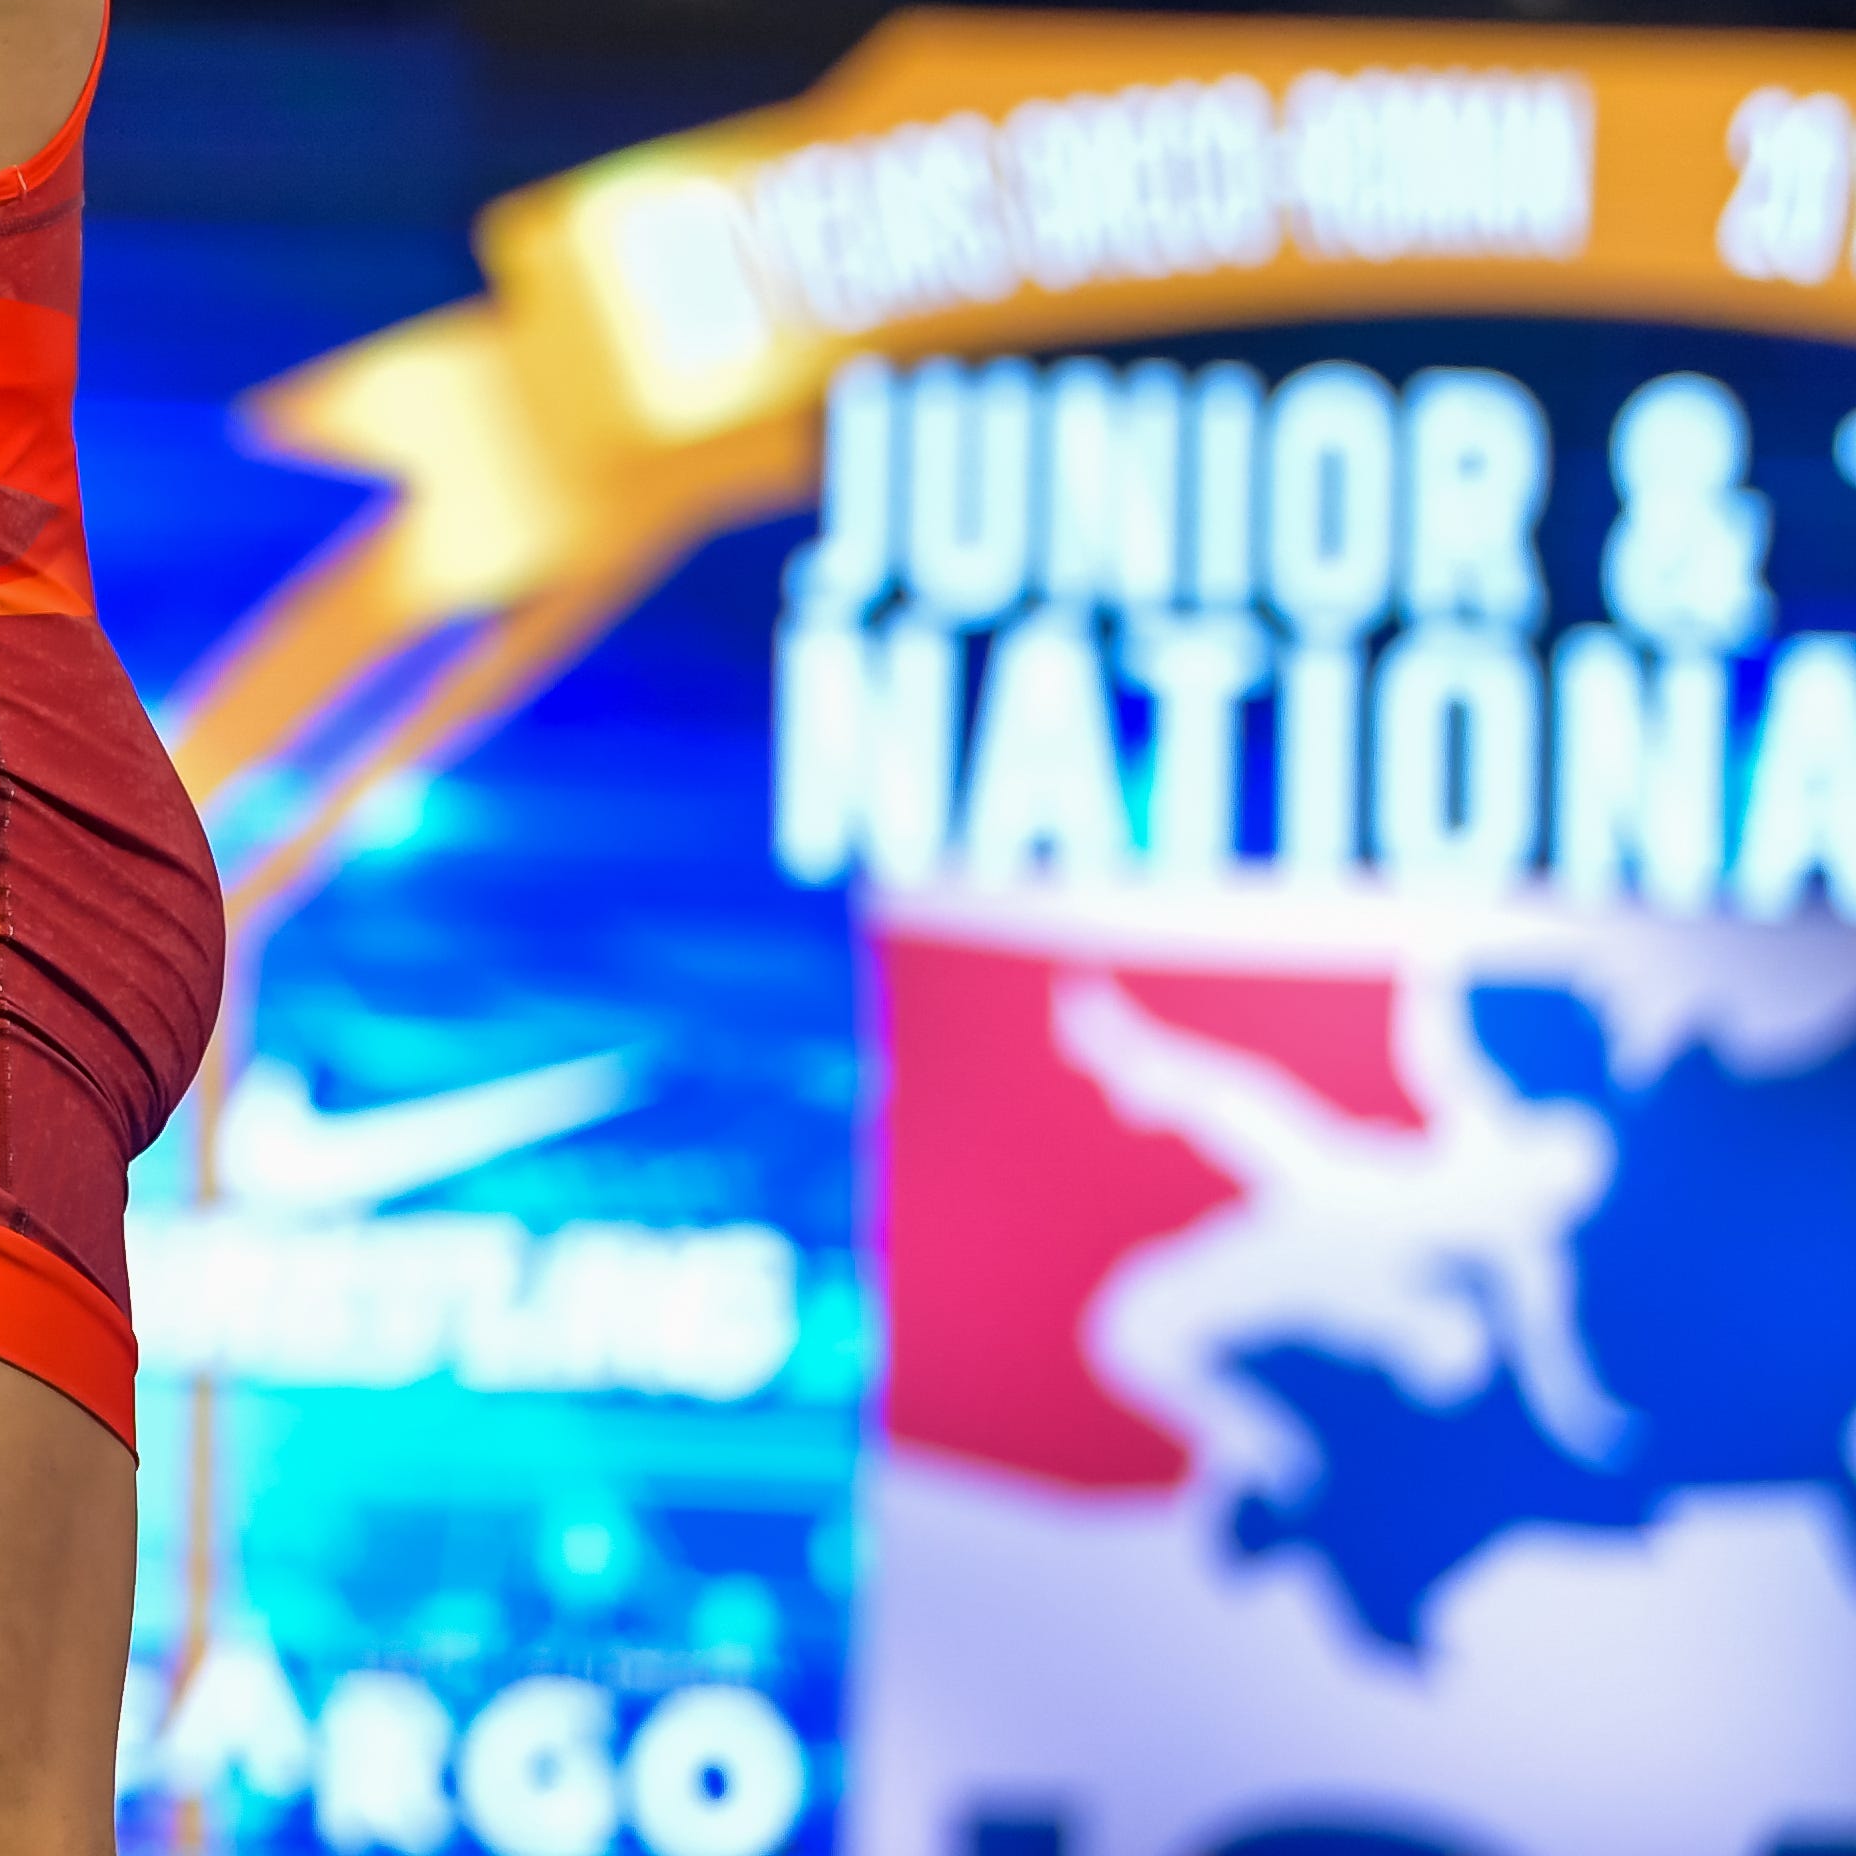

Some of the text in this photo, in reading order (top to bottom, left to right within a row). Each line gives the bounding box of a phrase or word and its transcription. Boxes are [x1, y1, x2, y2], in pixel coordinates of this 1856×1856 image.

[785, 352, 1777, 654] JUNIOR &
[774, 606, 1856, 919] NATIONA
